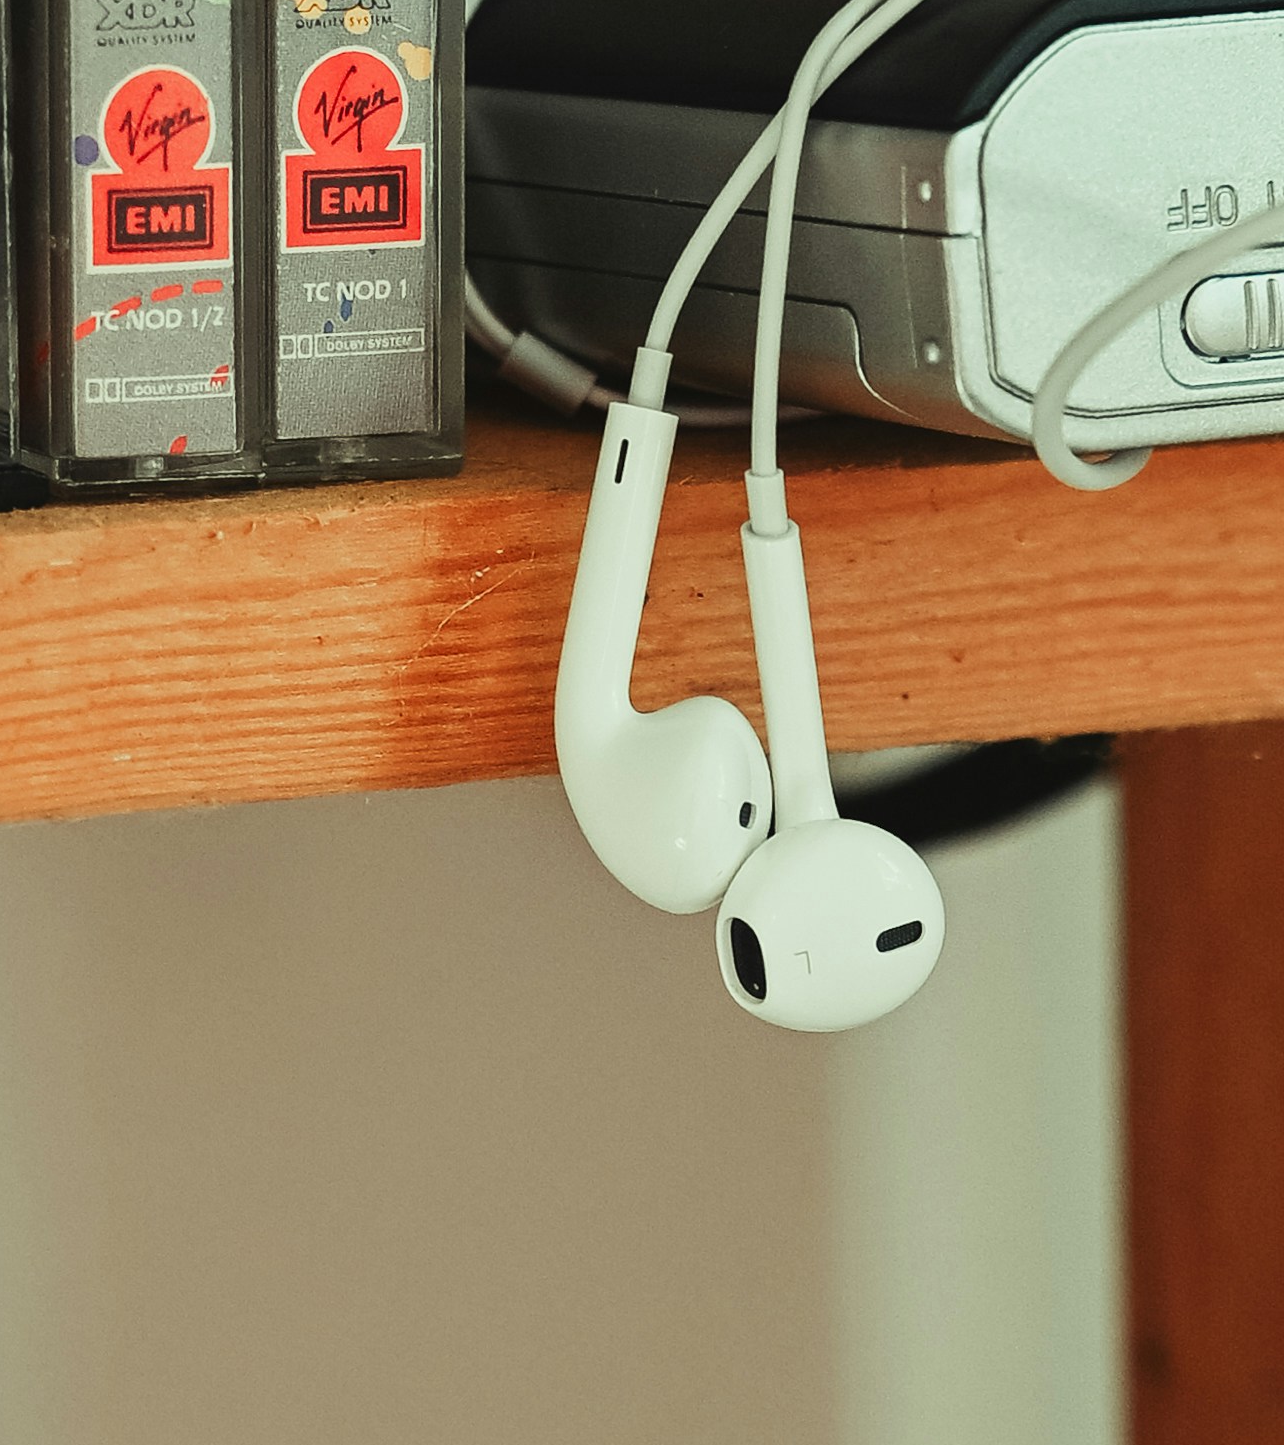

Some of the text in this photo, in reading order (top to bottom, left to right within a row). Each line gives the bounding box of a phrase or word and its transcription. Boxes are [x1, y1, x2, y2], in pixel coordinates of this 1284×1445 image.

[295, 15, 393, 30] QUALITY SYSTEM
[313, 65, 399, 153] Virgin
[119, 82, 206, 173] Virgin
[319, 185, 390, 215] EMI
[1166, 183, 1240, 232] OFF
[125, 204, 196, 236] EMI
[303, 277, 408, 303] TC NOD 1
[91, 306, 225, 332] TC NOD 1/2
[325, 334, 414, 353] DOLBY SYSTEM
[134, 380, 223, 397] DOLBY SYSTEM
